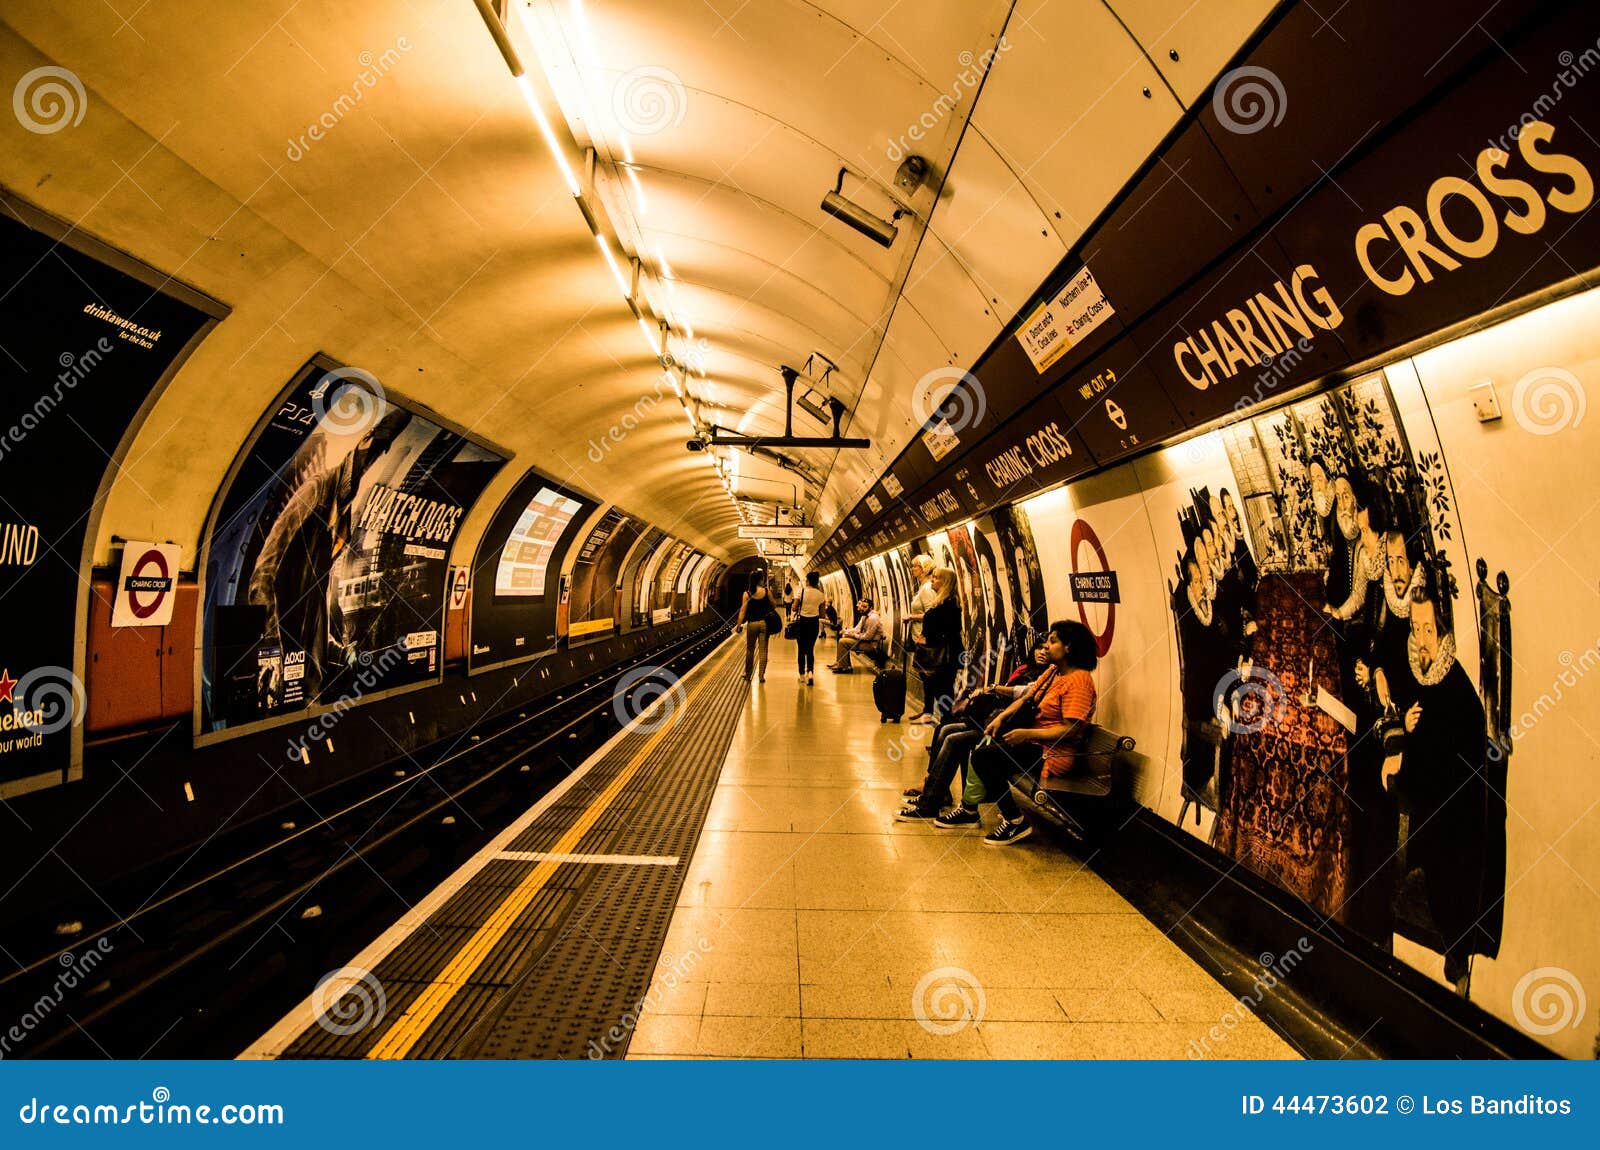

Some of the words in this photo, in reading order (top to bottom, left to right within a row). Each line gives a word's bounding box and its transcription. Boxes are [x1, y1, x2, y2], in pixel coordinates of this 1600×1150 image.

[1174, 264, 1344, 391] CHARING
[1355, 120, 1594, 295] CROSS
[1059, 286, 1081, 309] Northern
[83, 303, 161, 341] drinkaware.co.uk
[1072, 312, 1092, 331] Charing
[1087, 301, 1104, 317] Cross
[118, 331, 129, 339] for
[128, 335, 140, 343] the
[139, 338, 154, 349] facts
[1079, 383, 1094, 400] WAY
[1091, 374, 1107, 392] OUT
[278, 402, 317, 425] PS4
[985, 445, 1033, 488] CHARING
[1026, 422, 1072, 468] CROSS
[1075, 576, 1095, 589] CHARING
[1095, 575, 1111, 589] CROSS
[16, 731, 43, 750] world
